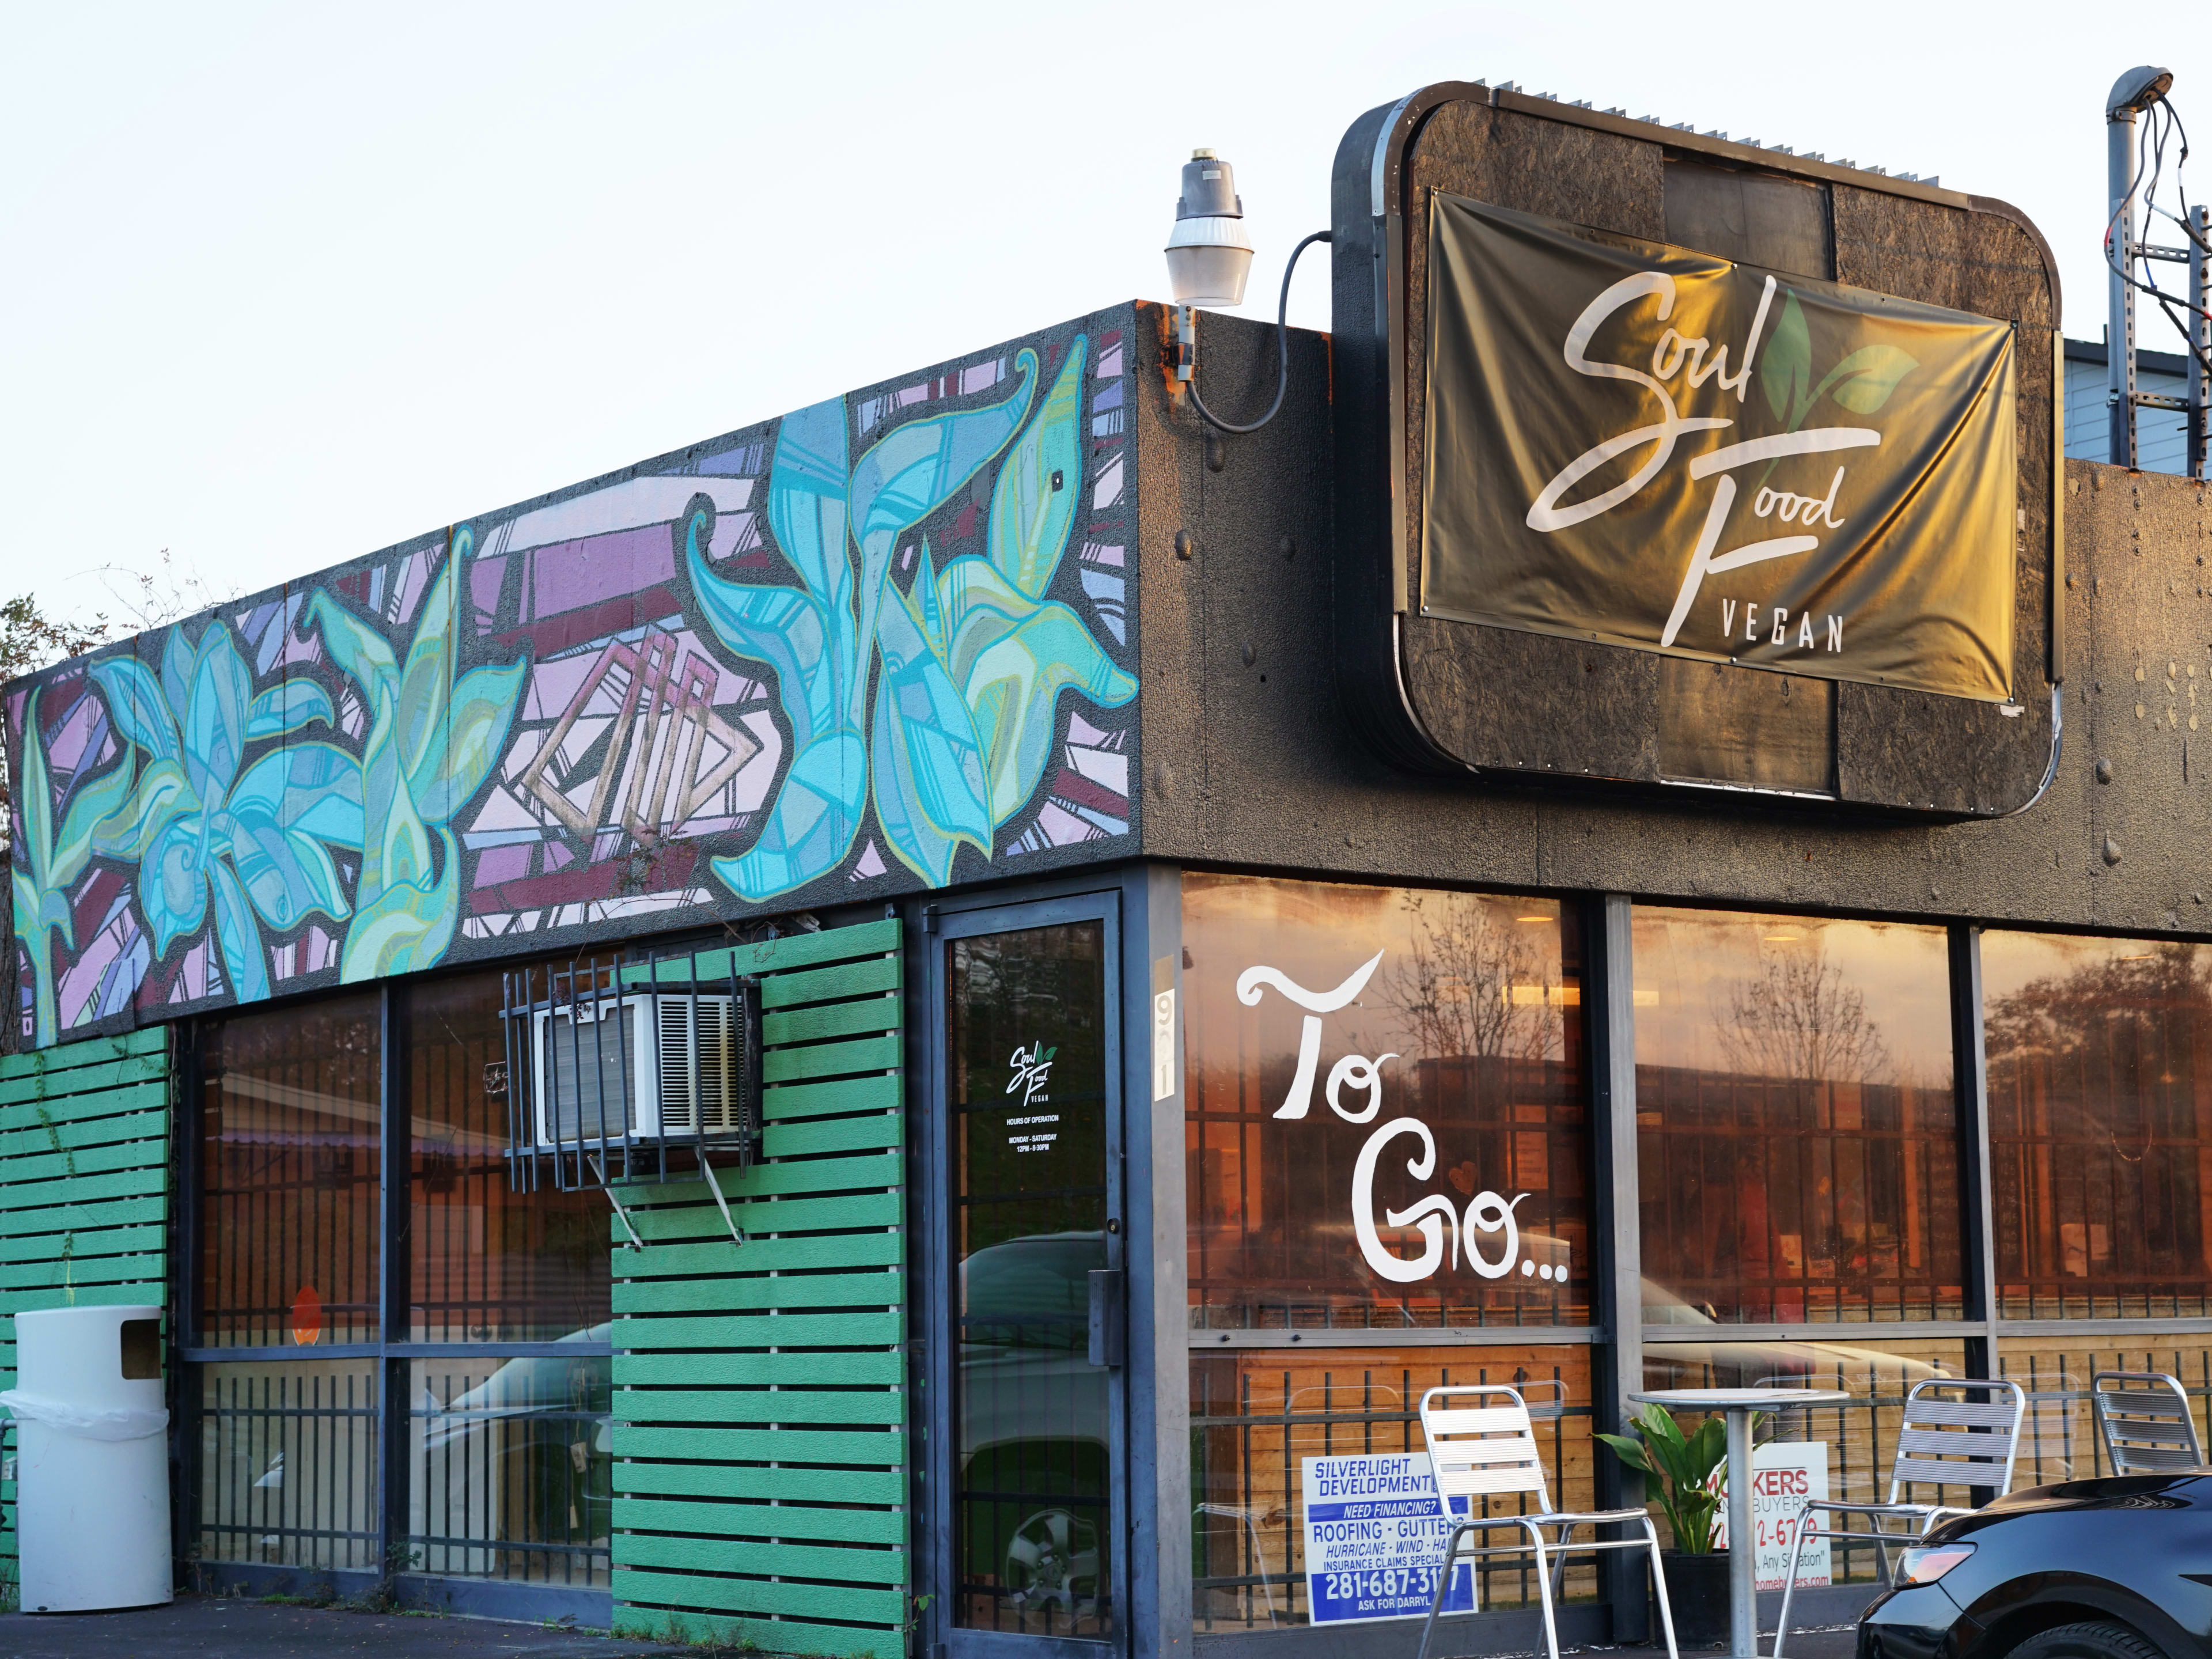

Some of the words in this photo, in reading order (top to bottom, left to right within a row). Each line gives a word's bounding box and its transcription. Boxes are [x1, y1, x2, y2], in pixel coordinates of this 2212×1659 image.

[1525, 271, 1777, 532] Soul
[1660, 426, 1881, 648] Food
[1722, 597, 1844, 653] VEGAN
[1236, 948, 1400, 1124] To
[1006, 1040, 1039, 1094] Soul
[1024, 1061, 1053, 1107] Food
[1031, 1094, 1049, 1103] VEGAN
[1006, 1118, 1024, 1126] HOURS
[1031, 1114, 1059, 1123] OPERATION
[1009, 1135, 1029, 1144] MONDAY
[1032, 1133, 1058, 1142] SATURDAY
[1017, 1145, 1029, 1153] 12PM
[1315, 1458, 1411, 1479] SILVERLIGHT
[1319, 1474, 1430, 1497] DEVELOPMENT
[1343, 1504, 1371, 1519] NEED
[1373, 1500, 1436, 1518] FINANCING?
[1313, 1521, 1382, 1543] ROOFING
[1326, 1541, 1387, 1559] HURRICANE
[1396, 1540, 1423, 1555] WIND
[1324, 1558, 1373, 1572] INSURANCE
[1376, 1556, 1408, 1570] CLAIMS
[1763, 1555, 1779, 1573] Any
[1358, 1599, 1376, 1611] ASK
[1377, 1597, 1396, 1609] FOR
[1397, 1595, 1431, 1608] DARRYL
